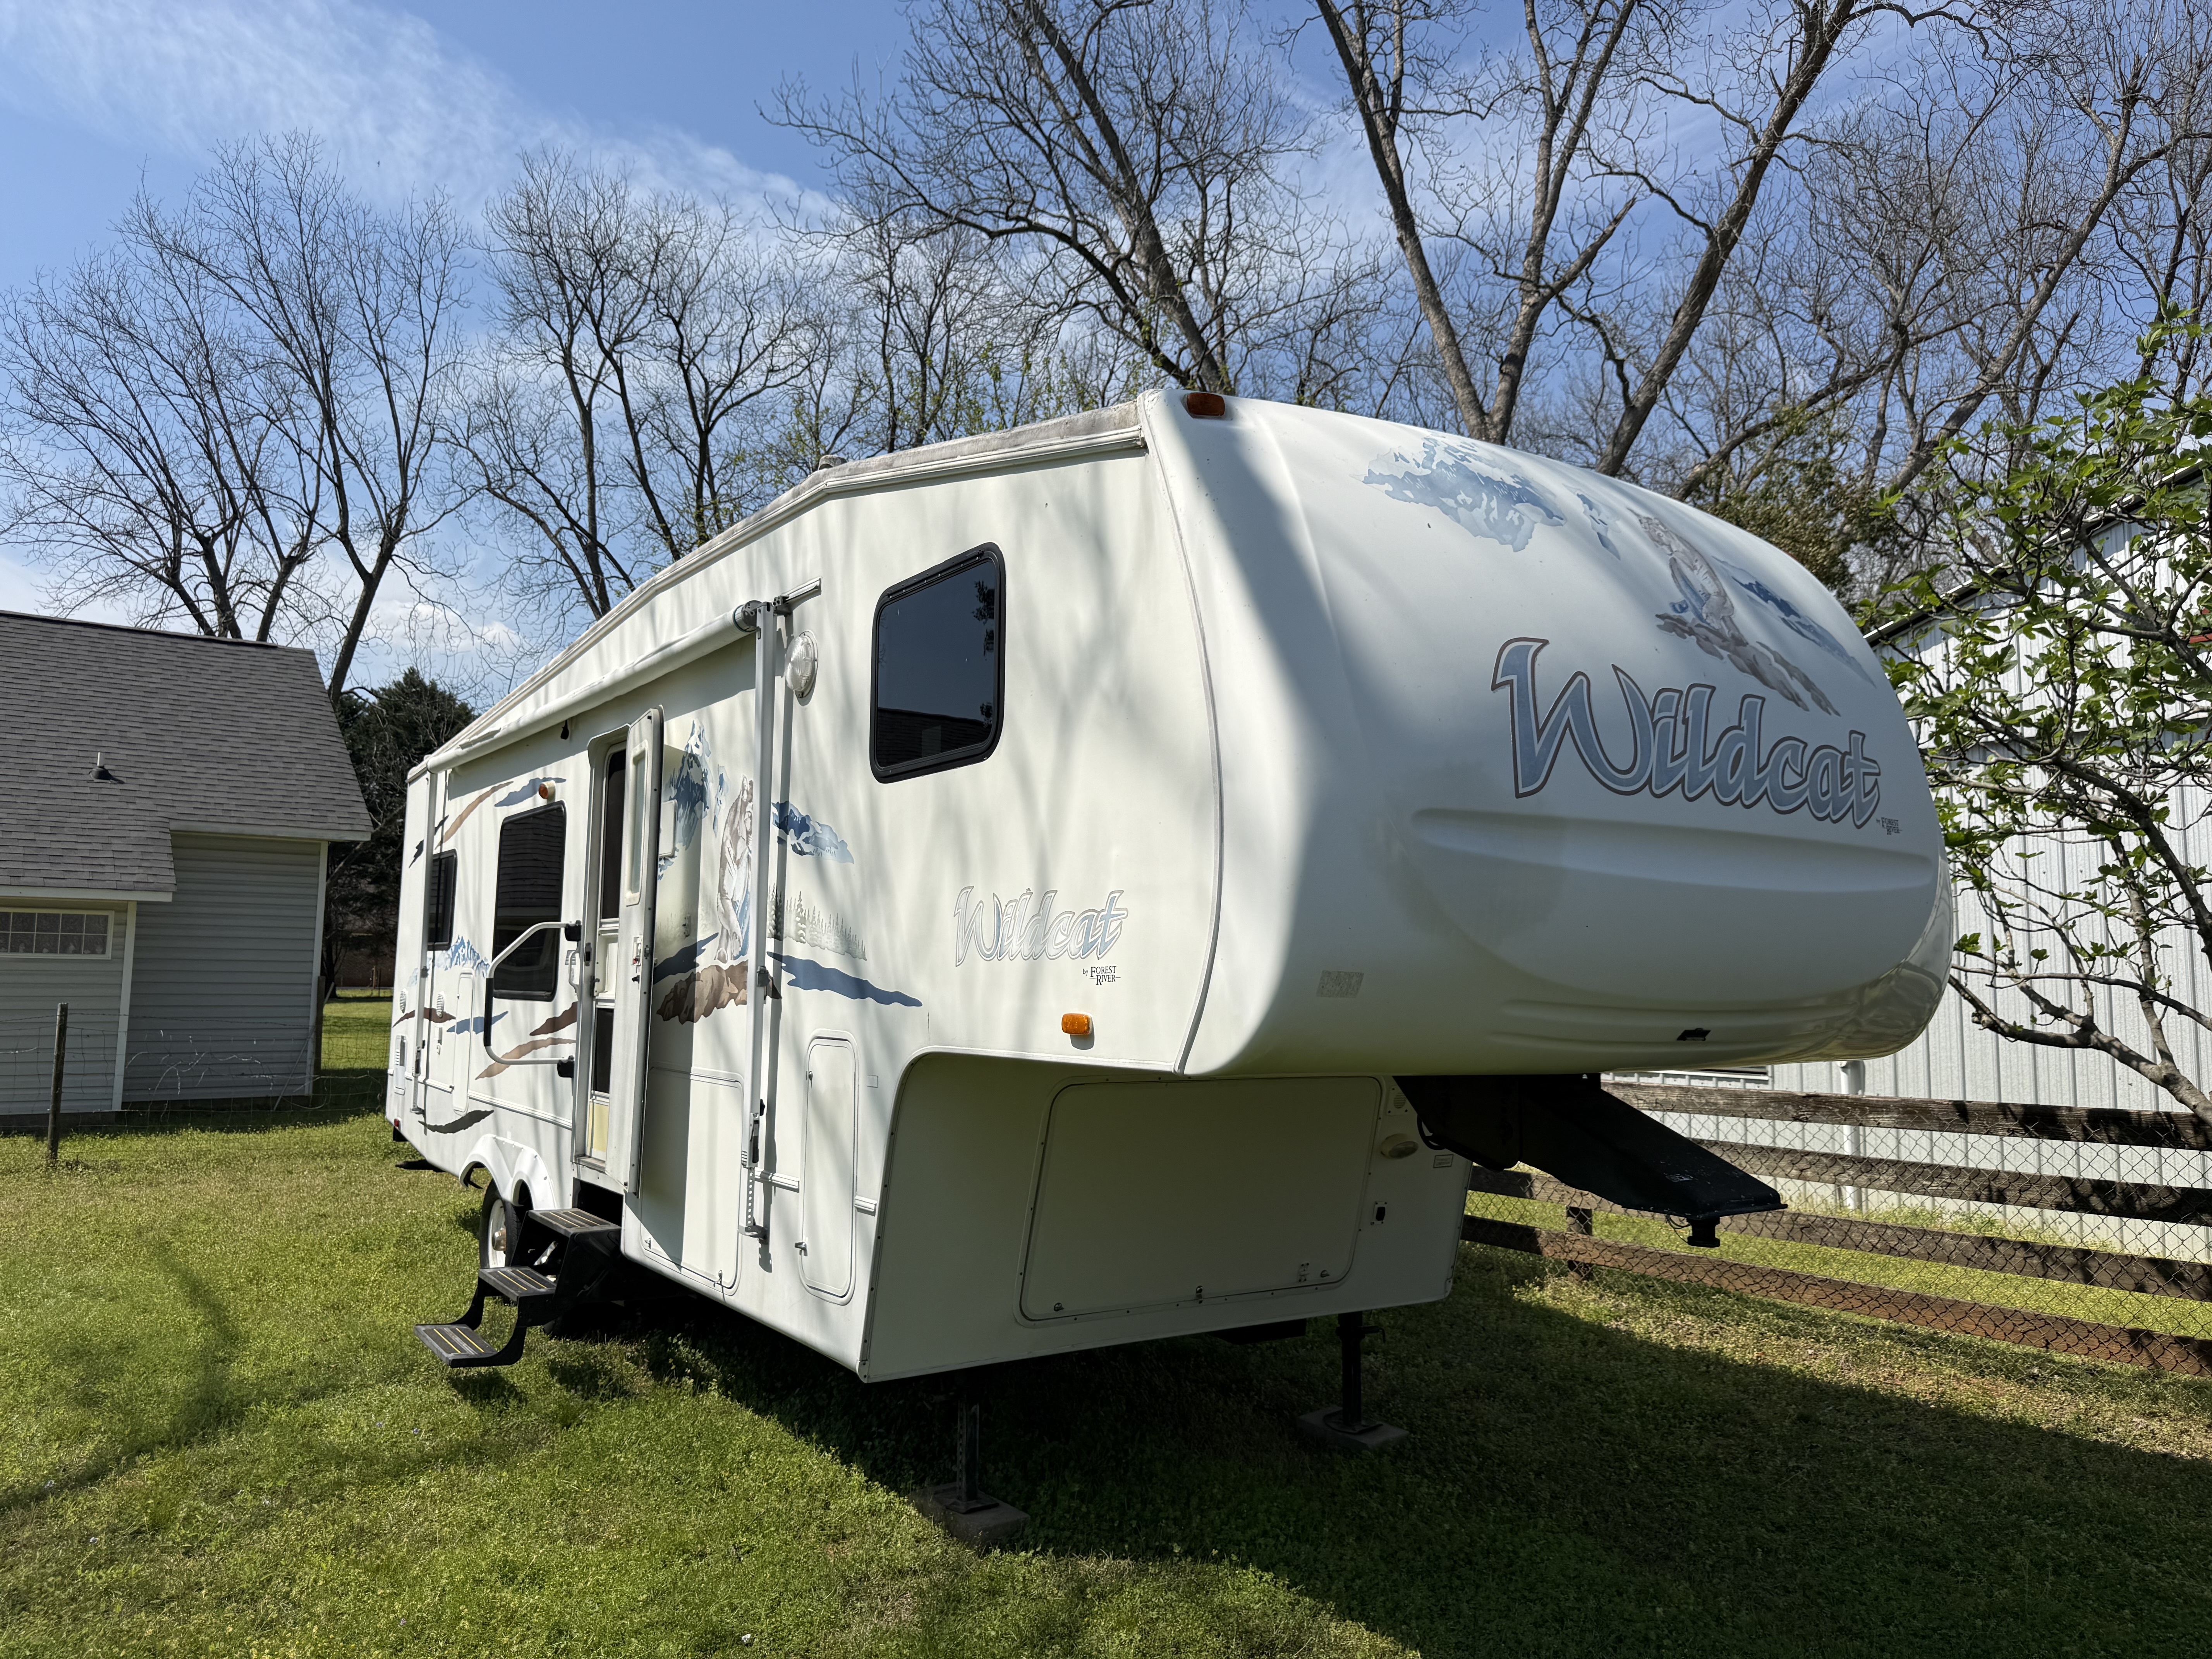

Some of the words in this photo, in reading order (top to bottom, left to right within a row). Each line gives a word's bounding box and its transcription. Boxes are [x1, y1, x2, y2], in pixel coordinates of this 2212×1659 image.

[1491, 637, 1881, 829] Wildcat
[1881, 817, 1898, 827] FOREST
[954, 886, 1128, 967] Wildcat
[1091, 966, 1116, 977] FOREST
[1096, 974, 1116, 985] RIVER
